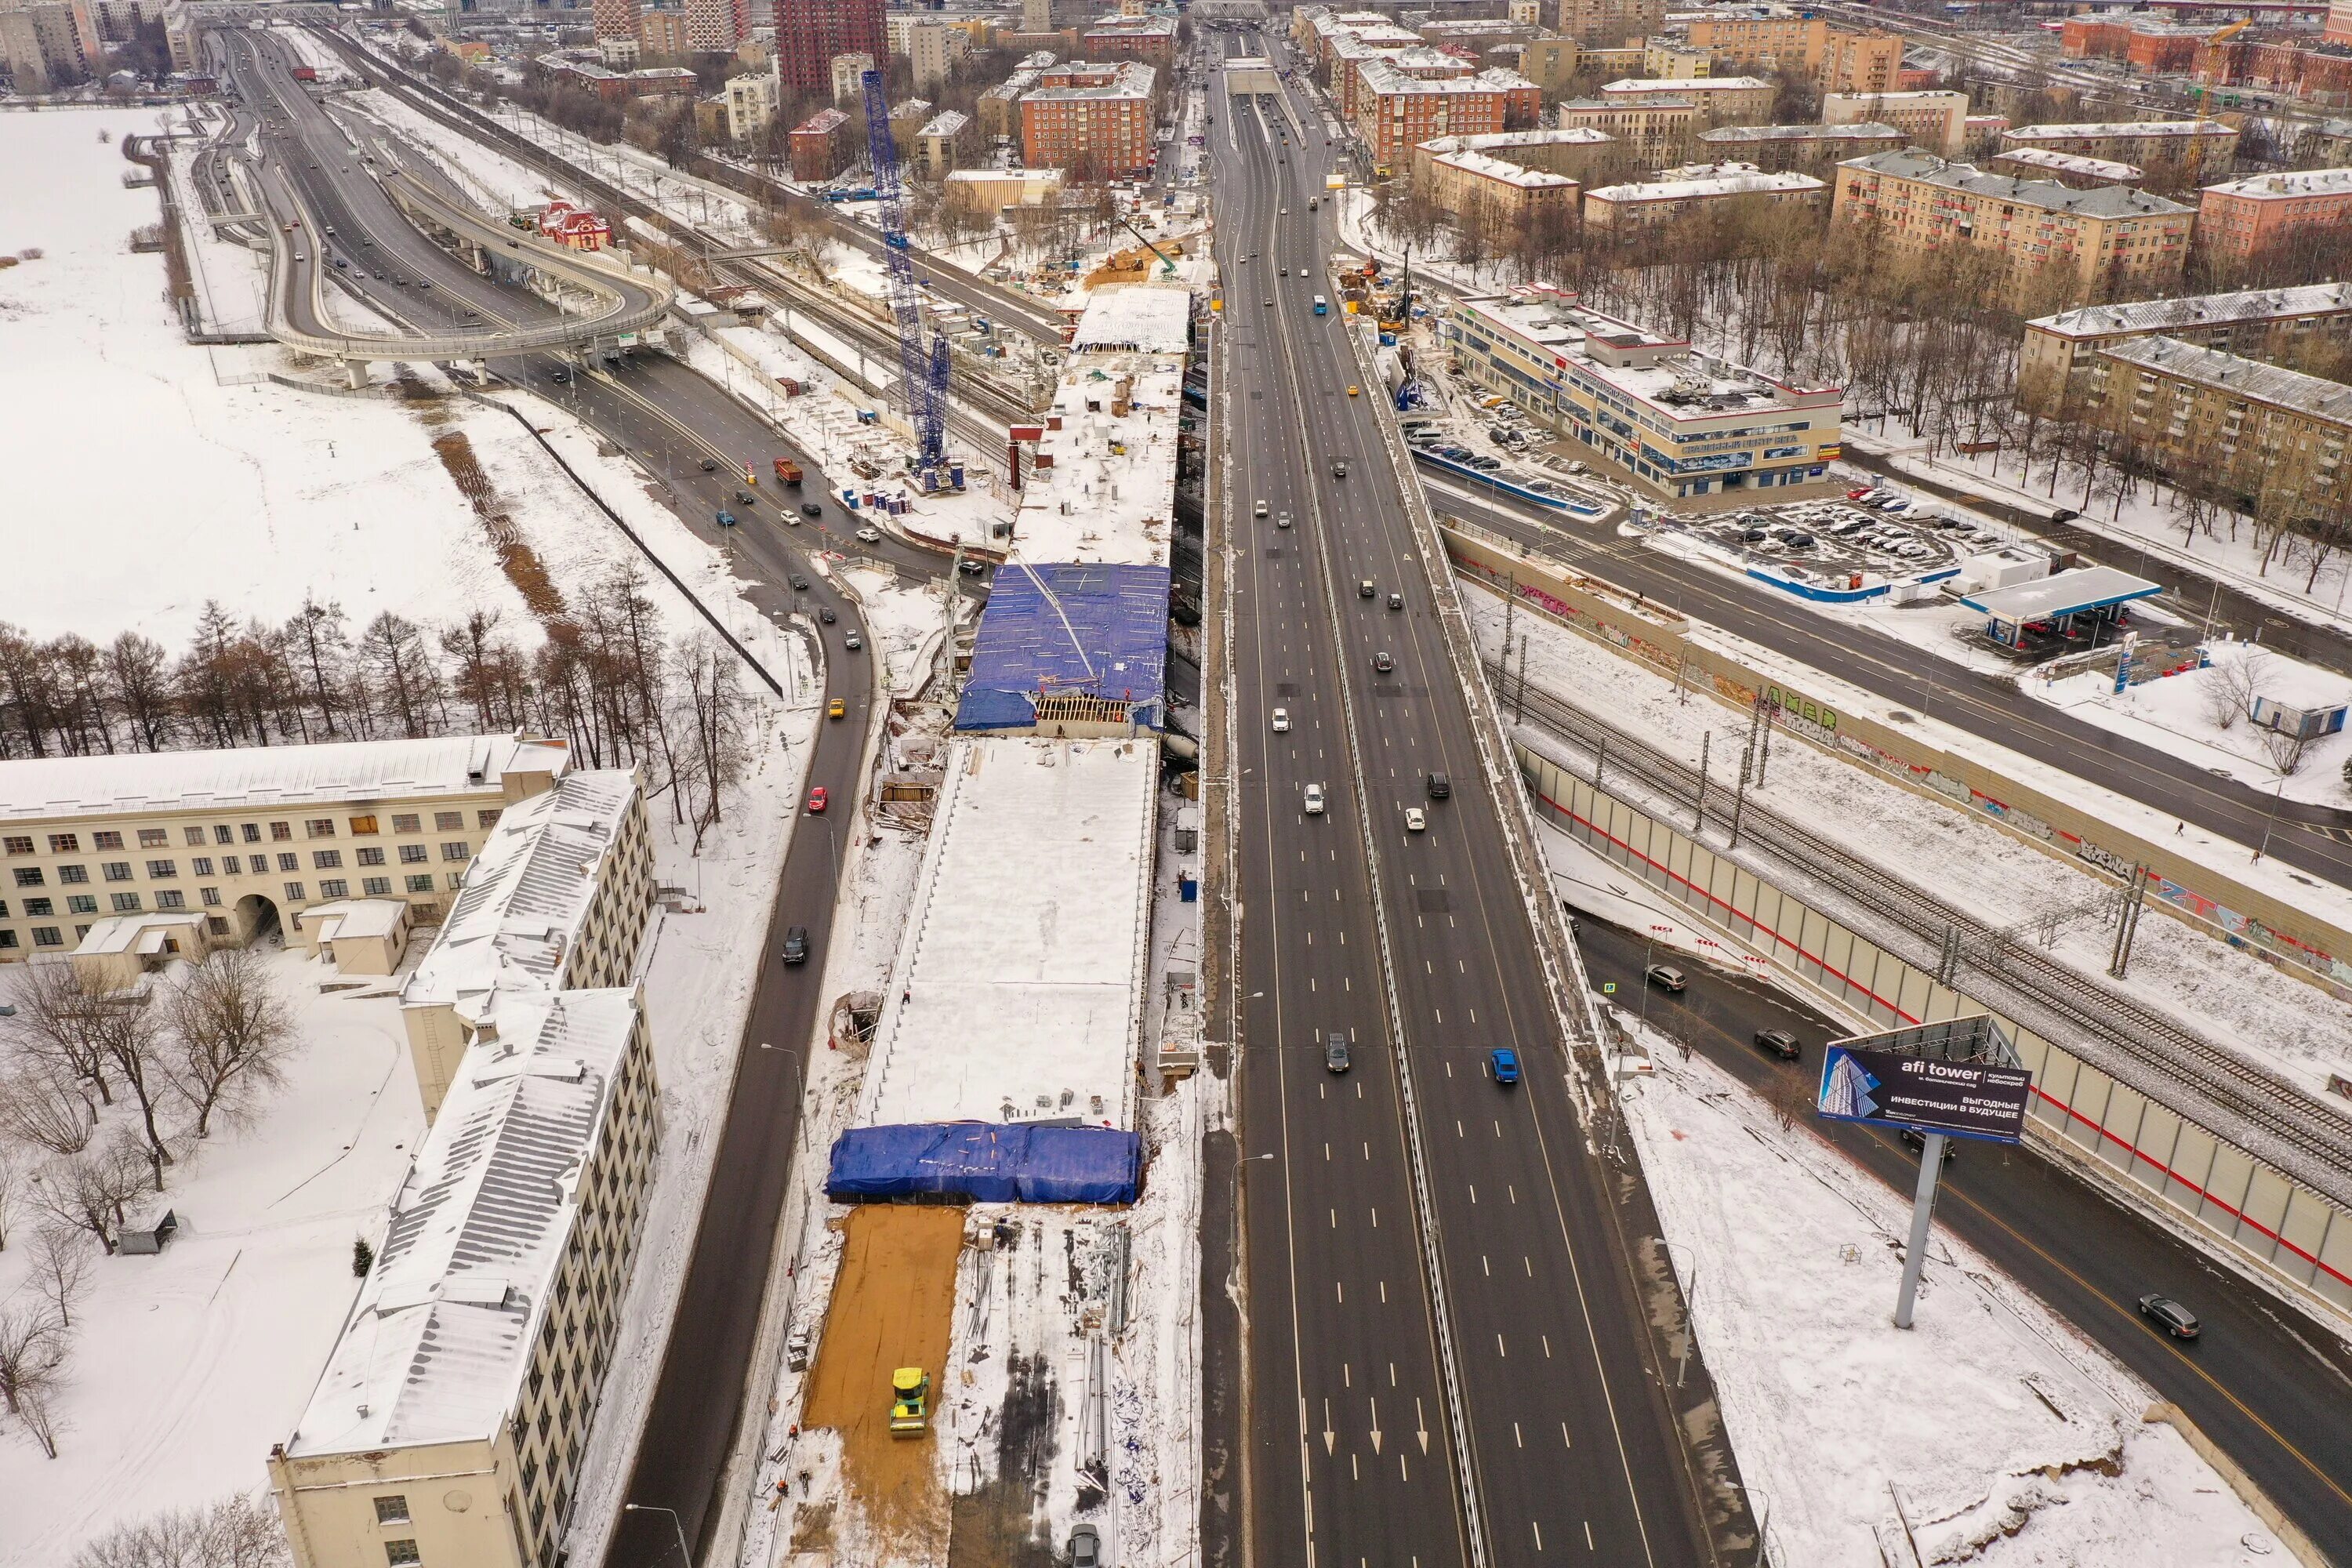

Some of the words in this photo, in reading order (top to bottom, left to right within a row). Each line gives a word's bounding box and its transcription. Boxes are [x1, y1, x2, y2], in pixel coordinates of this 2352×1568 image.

[1742, 437, 1772, 448] ЦЕНТР
[1774, 434, 1798, 444] ВЕГА
[1901, 1061, 1924, 1073] afi
[1928, 1062, 1982, 1080] tower
[1925, 1077, 1965, 1087] ботанический
[1987, 1073, 2025, 1082] культовый
[1987, 1078, 2024, 1087] небоскреб
[1890, 1095, 1957, 1111] ИНВЕСТИЦИИ
[1969, 1105, 2019, 1119] БУДУЩЕЕ
[1962, 1096, 2020, 1109] ВЫГОДНЫЕ
